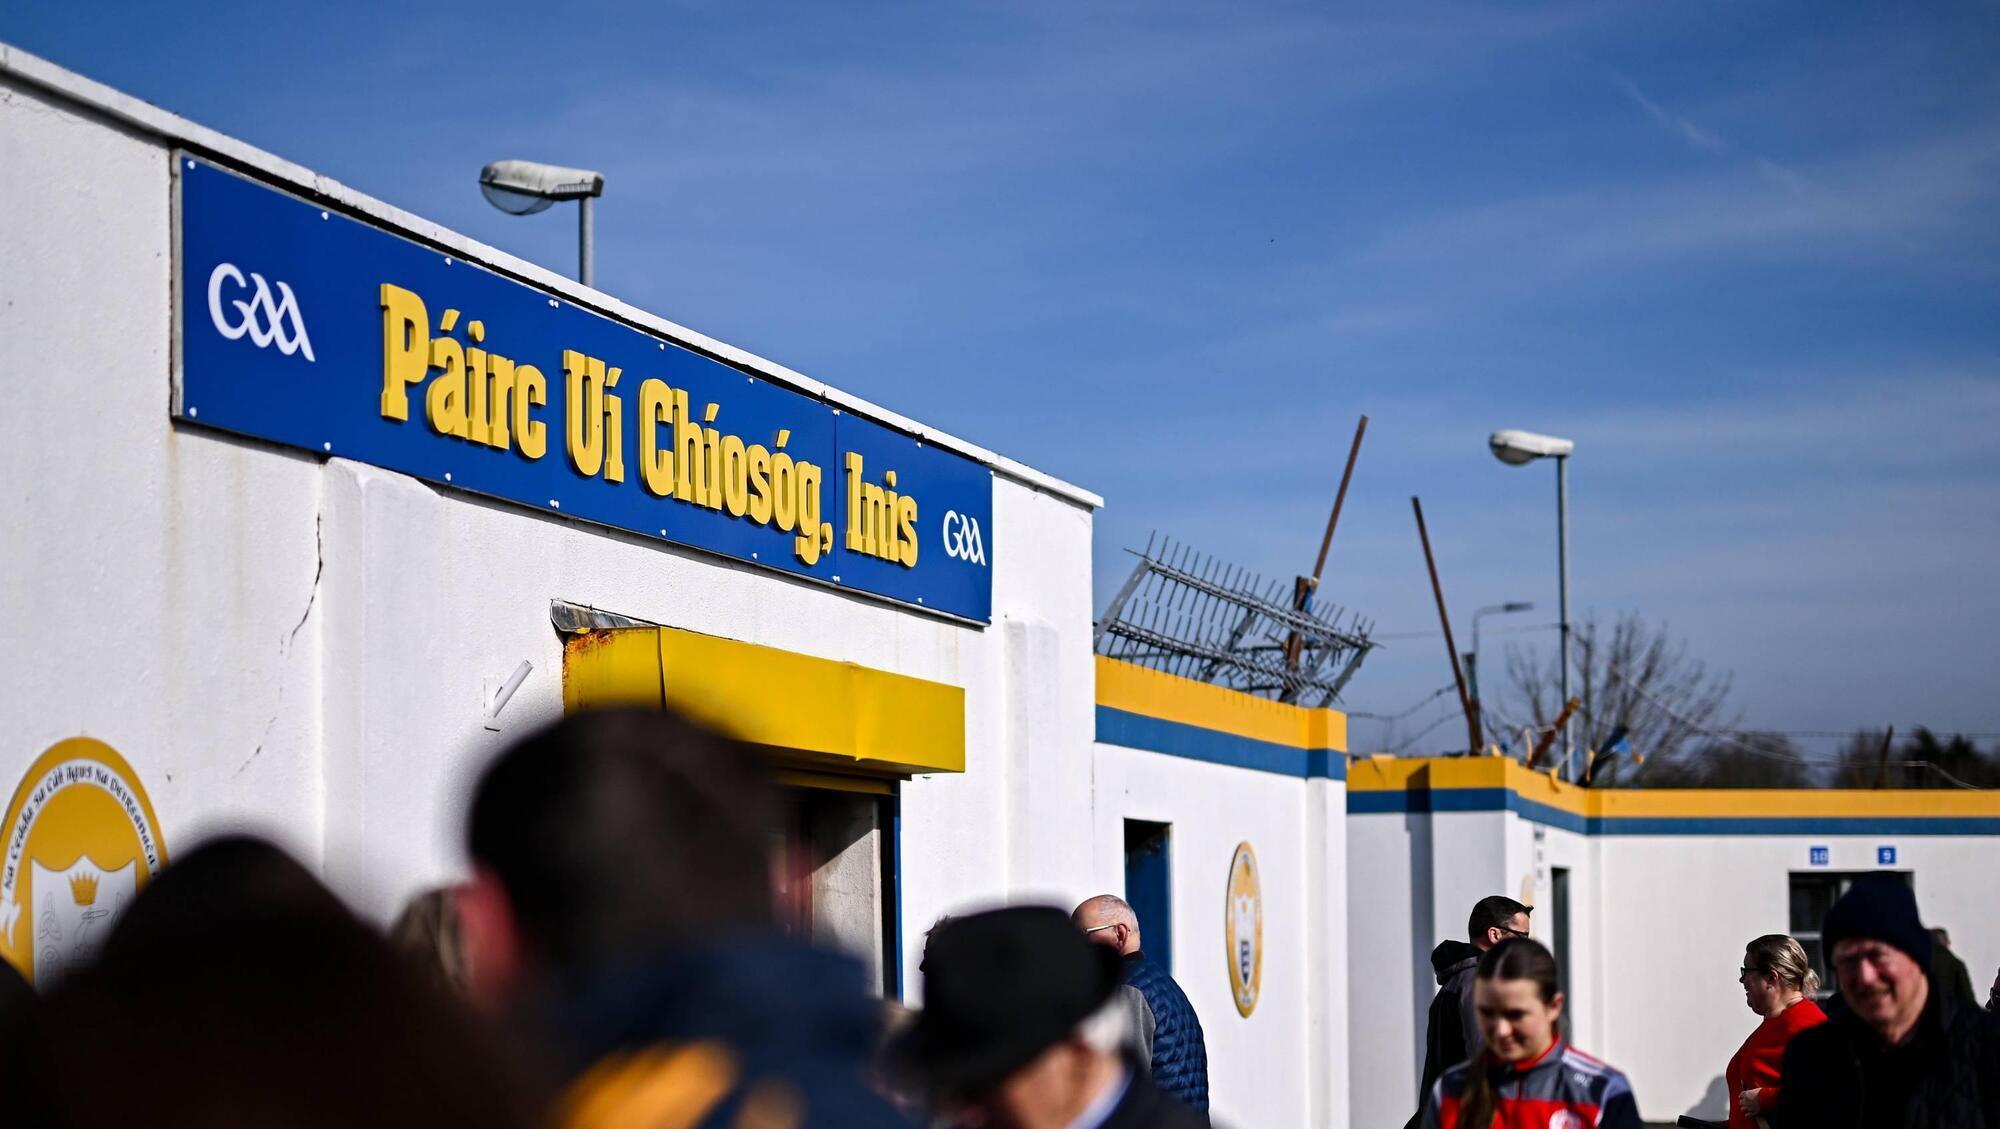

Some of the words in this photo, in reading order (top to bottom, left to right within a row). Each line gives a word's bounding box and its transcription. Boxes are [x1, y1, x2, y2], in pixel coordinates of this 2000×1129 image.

[208, 262, 316, 362] GAA
[380, 283, 546, 459] Páirc
[563, 349, 624, 483] Uí
[639, 378, 833, 566] Chíosóg,
[846, 451, 918, 568] Inis
[943, 510, 986, 566] GAA
